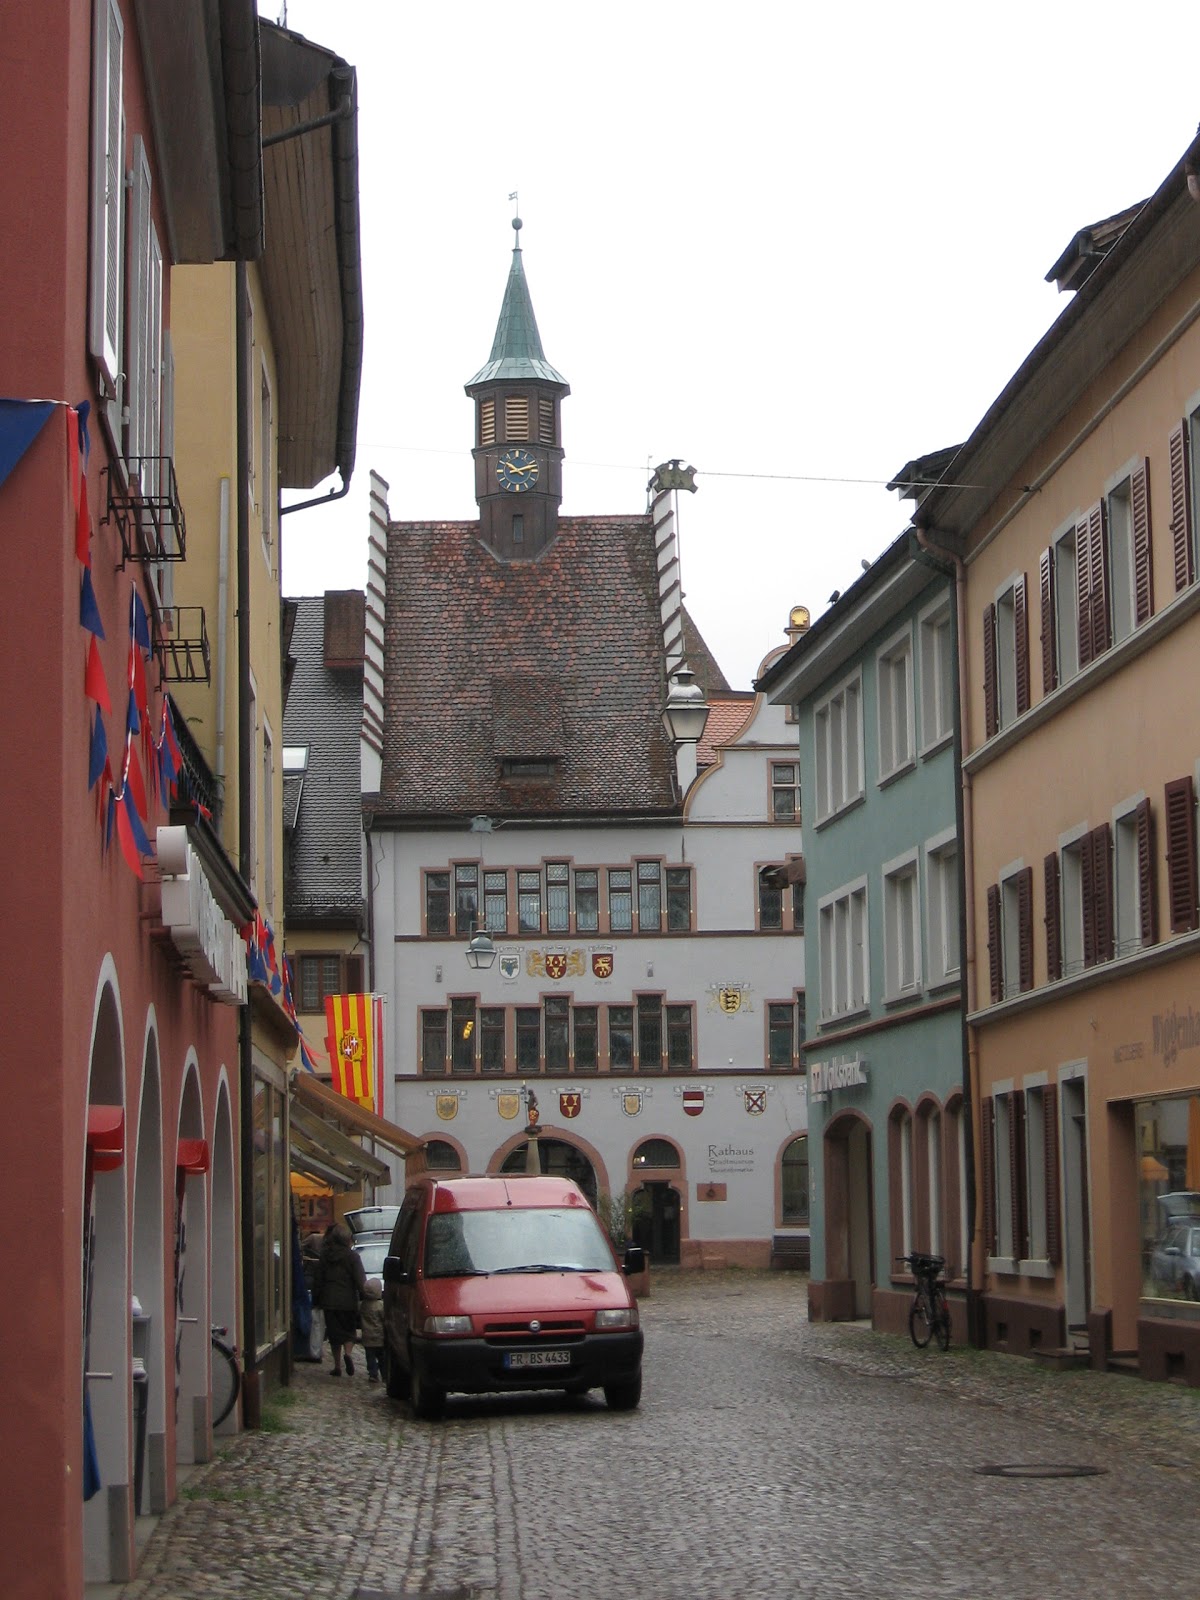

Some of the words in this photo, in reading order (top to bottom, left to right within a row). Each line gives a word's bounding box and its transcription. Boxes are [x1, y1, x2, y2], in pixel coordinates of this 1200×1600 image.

[822, 1051, 864, 1091] Volksbank
[708, 1144, 754, 1157] Rathaus
[510, 1354, 524, 1365] FR
[530, 1353, 543, 1364] BS
[545, 1352, 569, 1363] 4433
